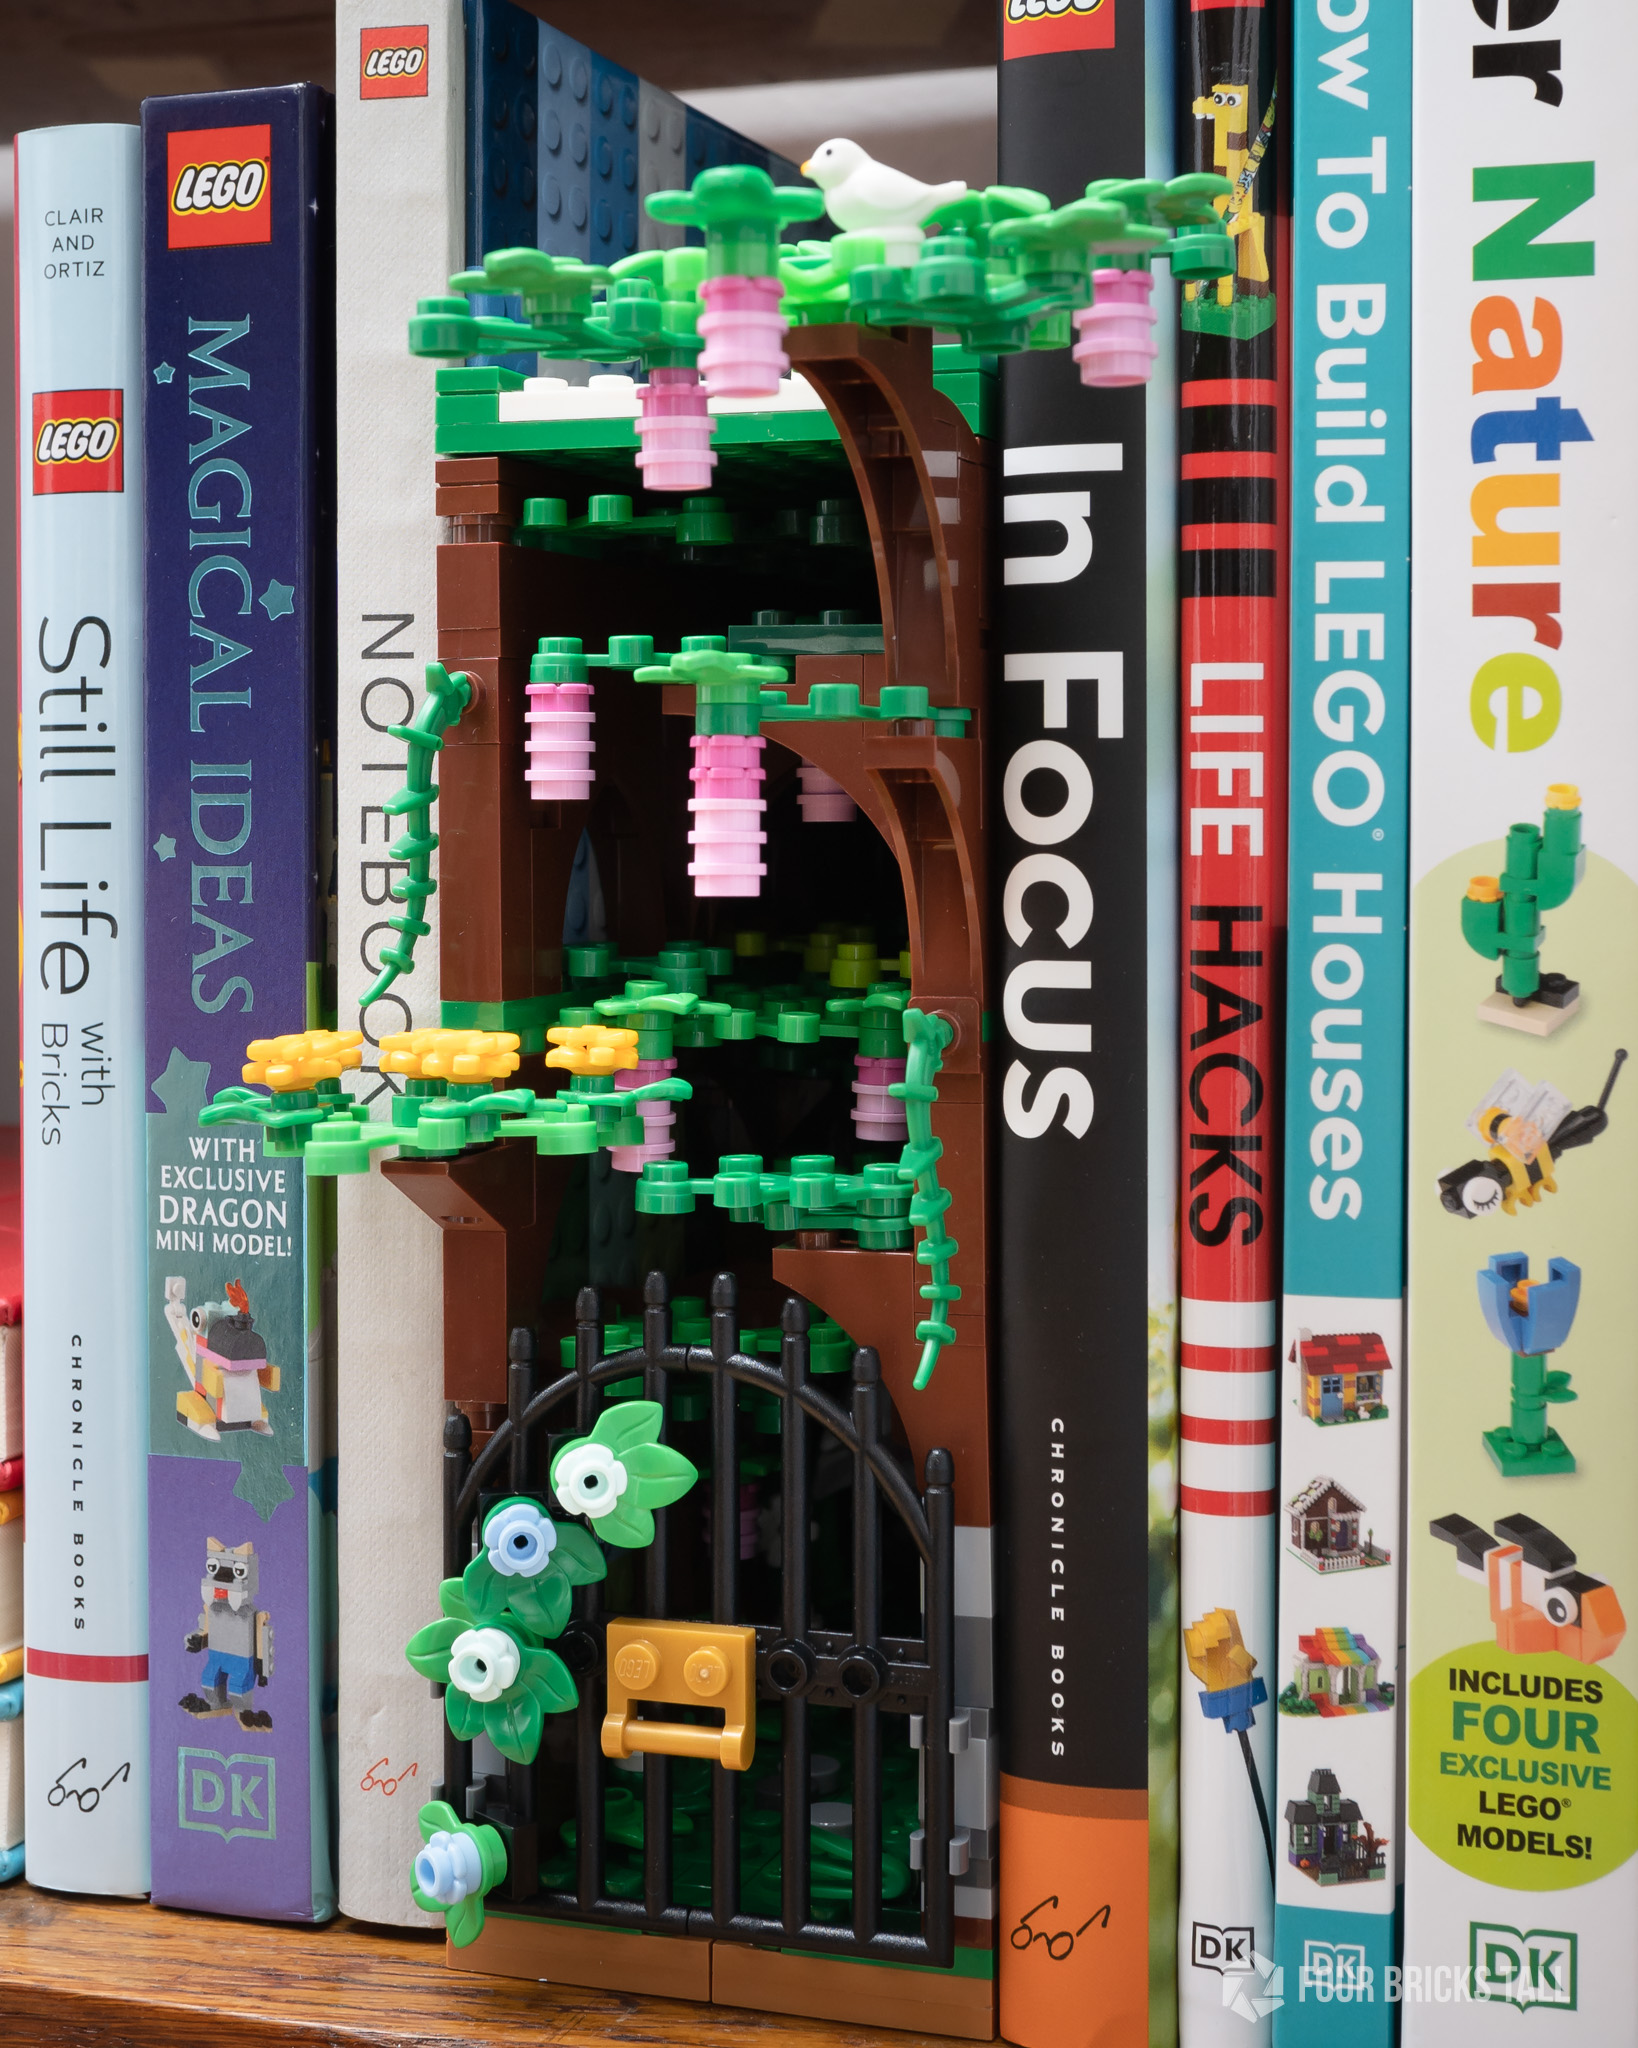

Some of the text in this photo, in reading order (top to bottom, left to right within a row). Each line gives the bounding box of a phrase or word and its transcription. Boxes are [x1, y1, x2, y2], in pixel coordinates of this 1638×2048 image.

[363, 48, 423, 78] LEGO
[173, 163, 265, 210] LEGO
[1315, 136, 1387, 250] To
[44, 207, 104, 228] CLAIR
[52, 234, 95, 253] AND
[43, 260, 105, 281] ORTIZ
[1313, 283, 1386, 522] Build
[36, 419, 117, 462] LEGO
[1470, 160, 1595, 753] Nature
[188, 313, 255, 1014] MAGICAL IDEAS
[38, 616, 118, 995] Still Life
[1003, 442, 1124, 1140] In Focus
[1189, 661, 1264, 1247] LIFE HACKS
[81, 1021, 116, 1106] with
[1309, 872, 1383, 1220] Houses
[41, 1023, 69, 1146] Bricks
[188, 1137, 256, 1163] WITH
[160, 1165, 286, 1194] EXCLUSIVE
[159, 1196, 287, 1230] DRAGON
[155, 1230, 292, 1257] MINI MODEL!
[70, 1335, 86, 1630] CHRONICLE BOOKS
[1051, 1418, 1065, 1757] CHRONICLE BOOKS
[1449, 1667, 1603, 1704] INCLUDES
[1453, 1700, 1600, 1753] FOUR
[191, 1768, 264, 1821] DK
[1440, 1751, 1611, 1790] EXCLUSIVE
[1457, 1824, 1593, 1860] MODELS!
[1199, 1935, 1246, 1963] DK
[1313, 1951, 1357, 1980] DK
[1485, 1942, 1563, 1993] DK
